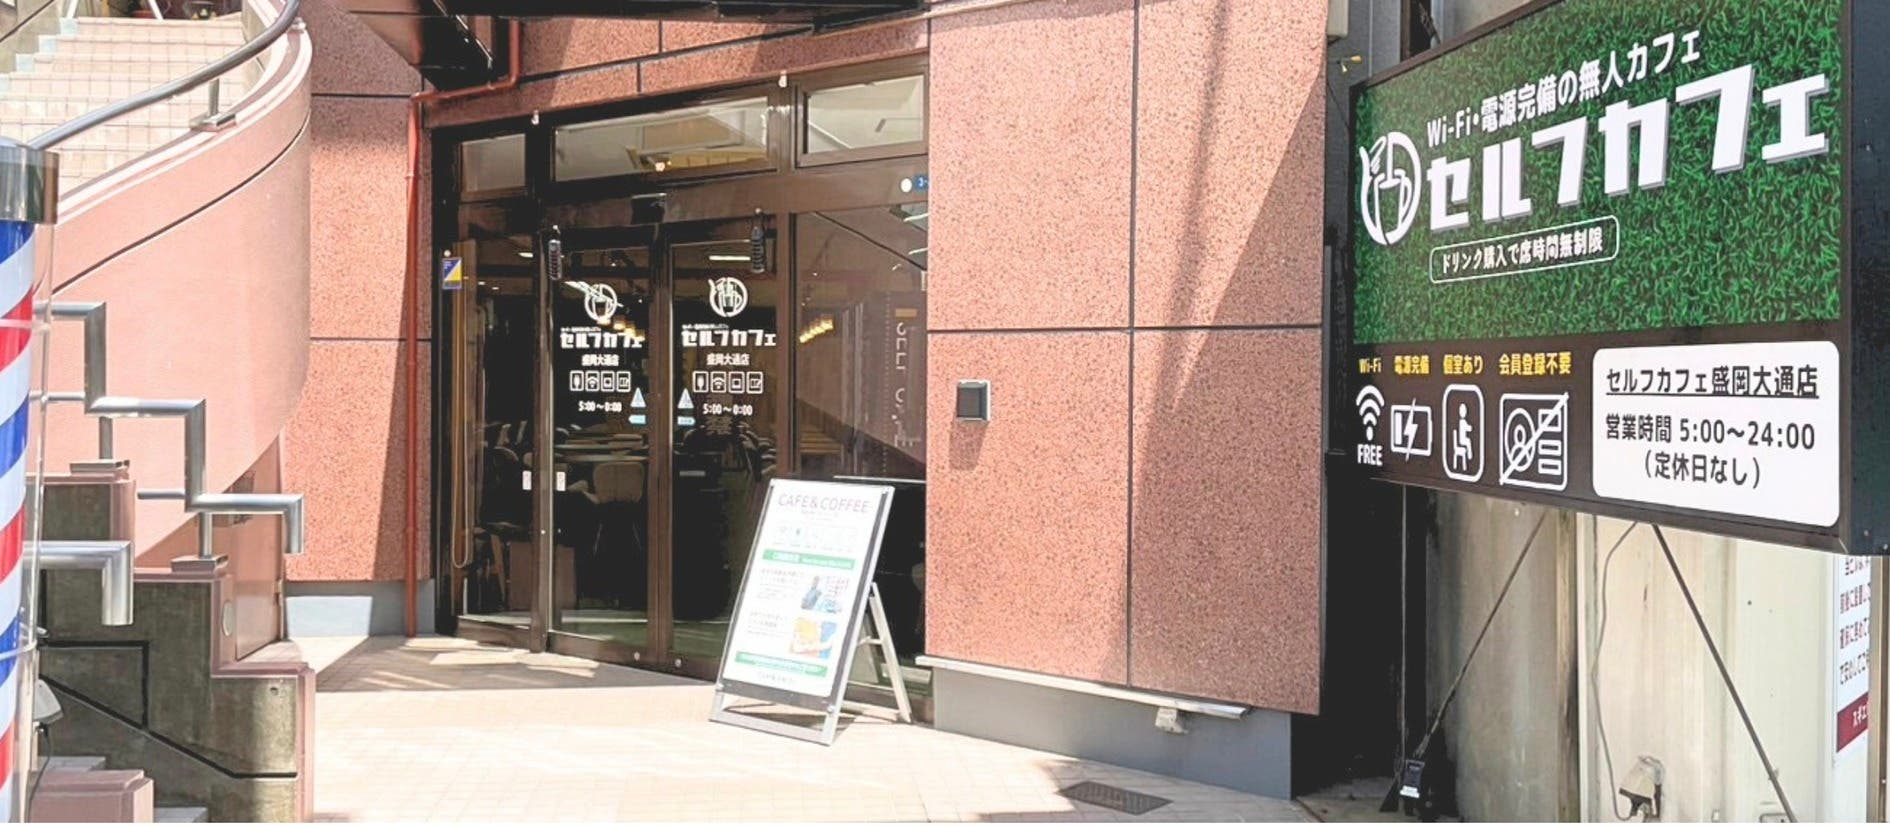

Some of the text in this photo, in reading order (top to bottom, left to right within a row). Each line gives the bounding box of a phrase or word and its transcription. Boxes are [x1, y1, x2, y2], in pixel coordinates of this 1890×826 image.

[1426, 64, 1829, 231] セルフカフェ
[1442, 226, 1604, 274] ドリンク購入で席時間無制限
[682, 328, 777, 347] セルフカフェ
[1358, 357, 1382, 374] Wi-Fi
[1394, 354, 1430, 375] 電源完備
[1443, 353, 1484, 375] 個室あり
[1499, 351, 1572, 376] 会員登録不要
[1606, 363, 1819, 398] セルフカフェ盛岡大通店
[1606, 413, 1672, 443] 営業時間
[1357, 444, 1383, 466] FREE
